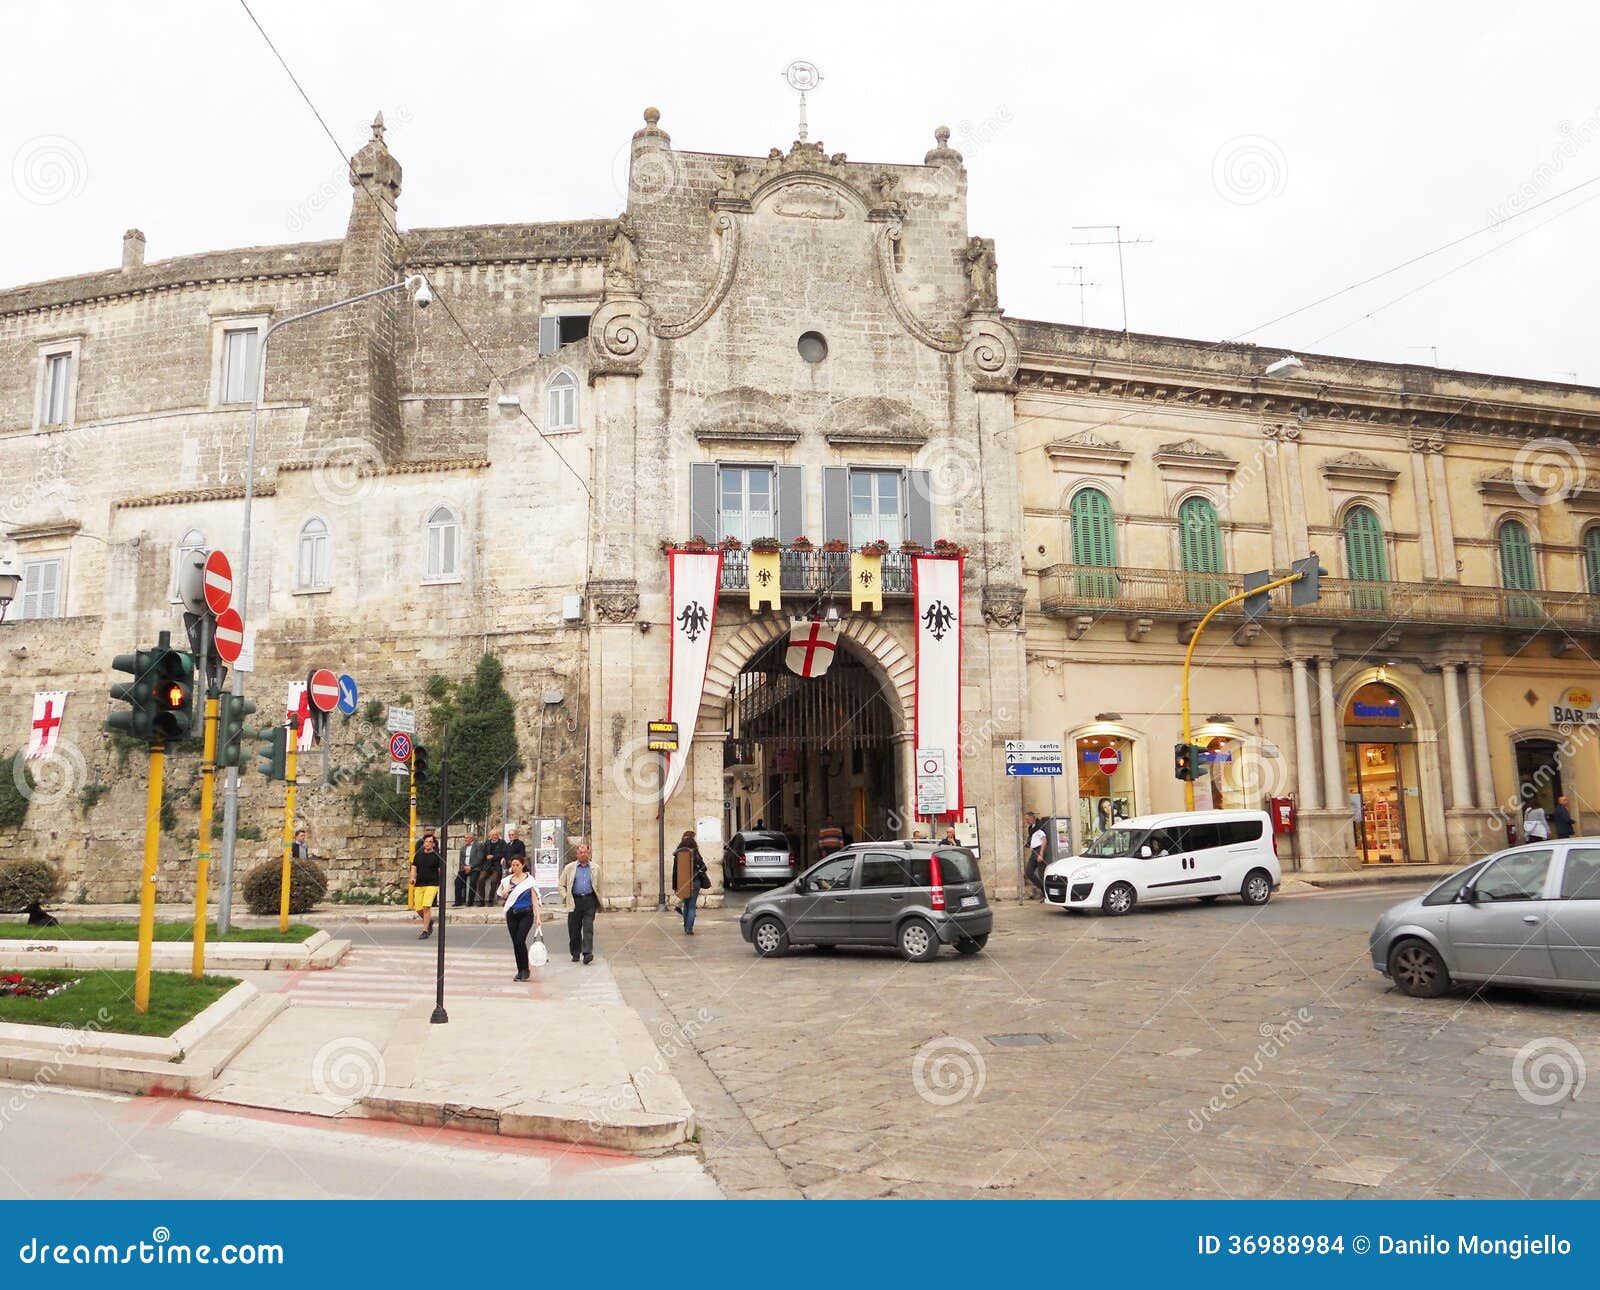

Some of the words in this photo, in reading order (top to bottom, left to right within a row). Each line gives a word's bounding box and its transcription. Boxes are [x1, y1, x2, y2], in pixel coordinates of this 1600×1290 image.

[1553, 706, 1584, 722] BAR
[1031, 753, 1061, 762] municipio
[1033, 766, 1061, 774] MATERA
